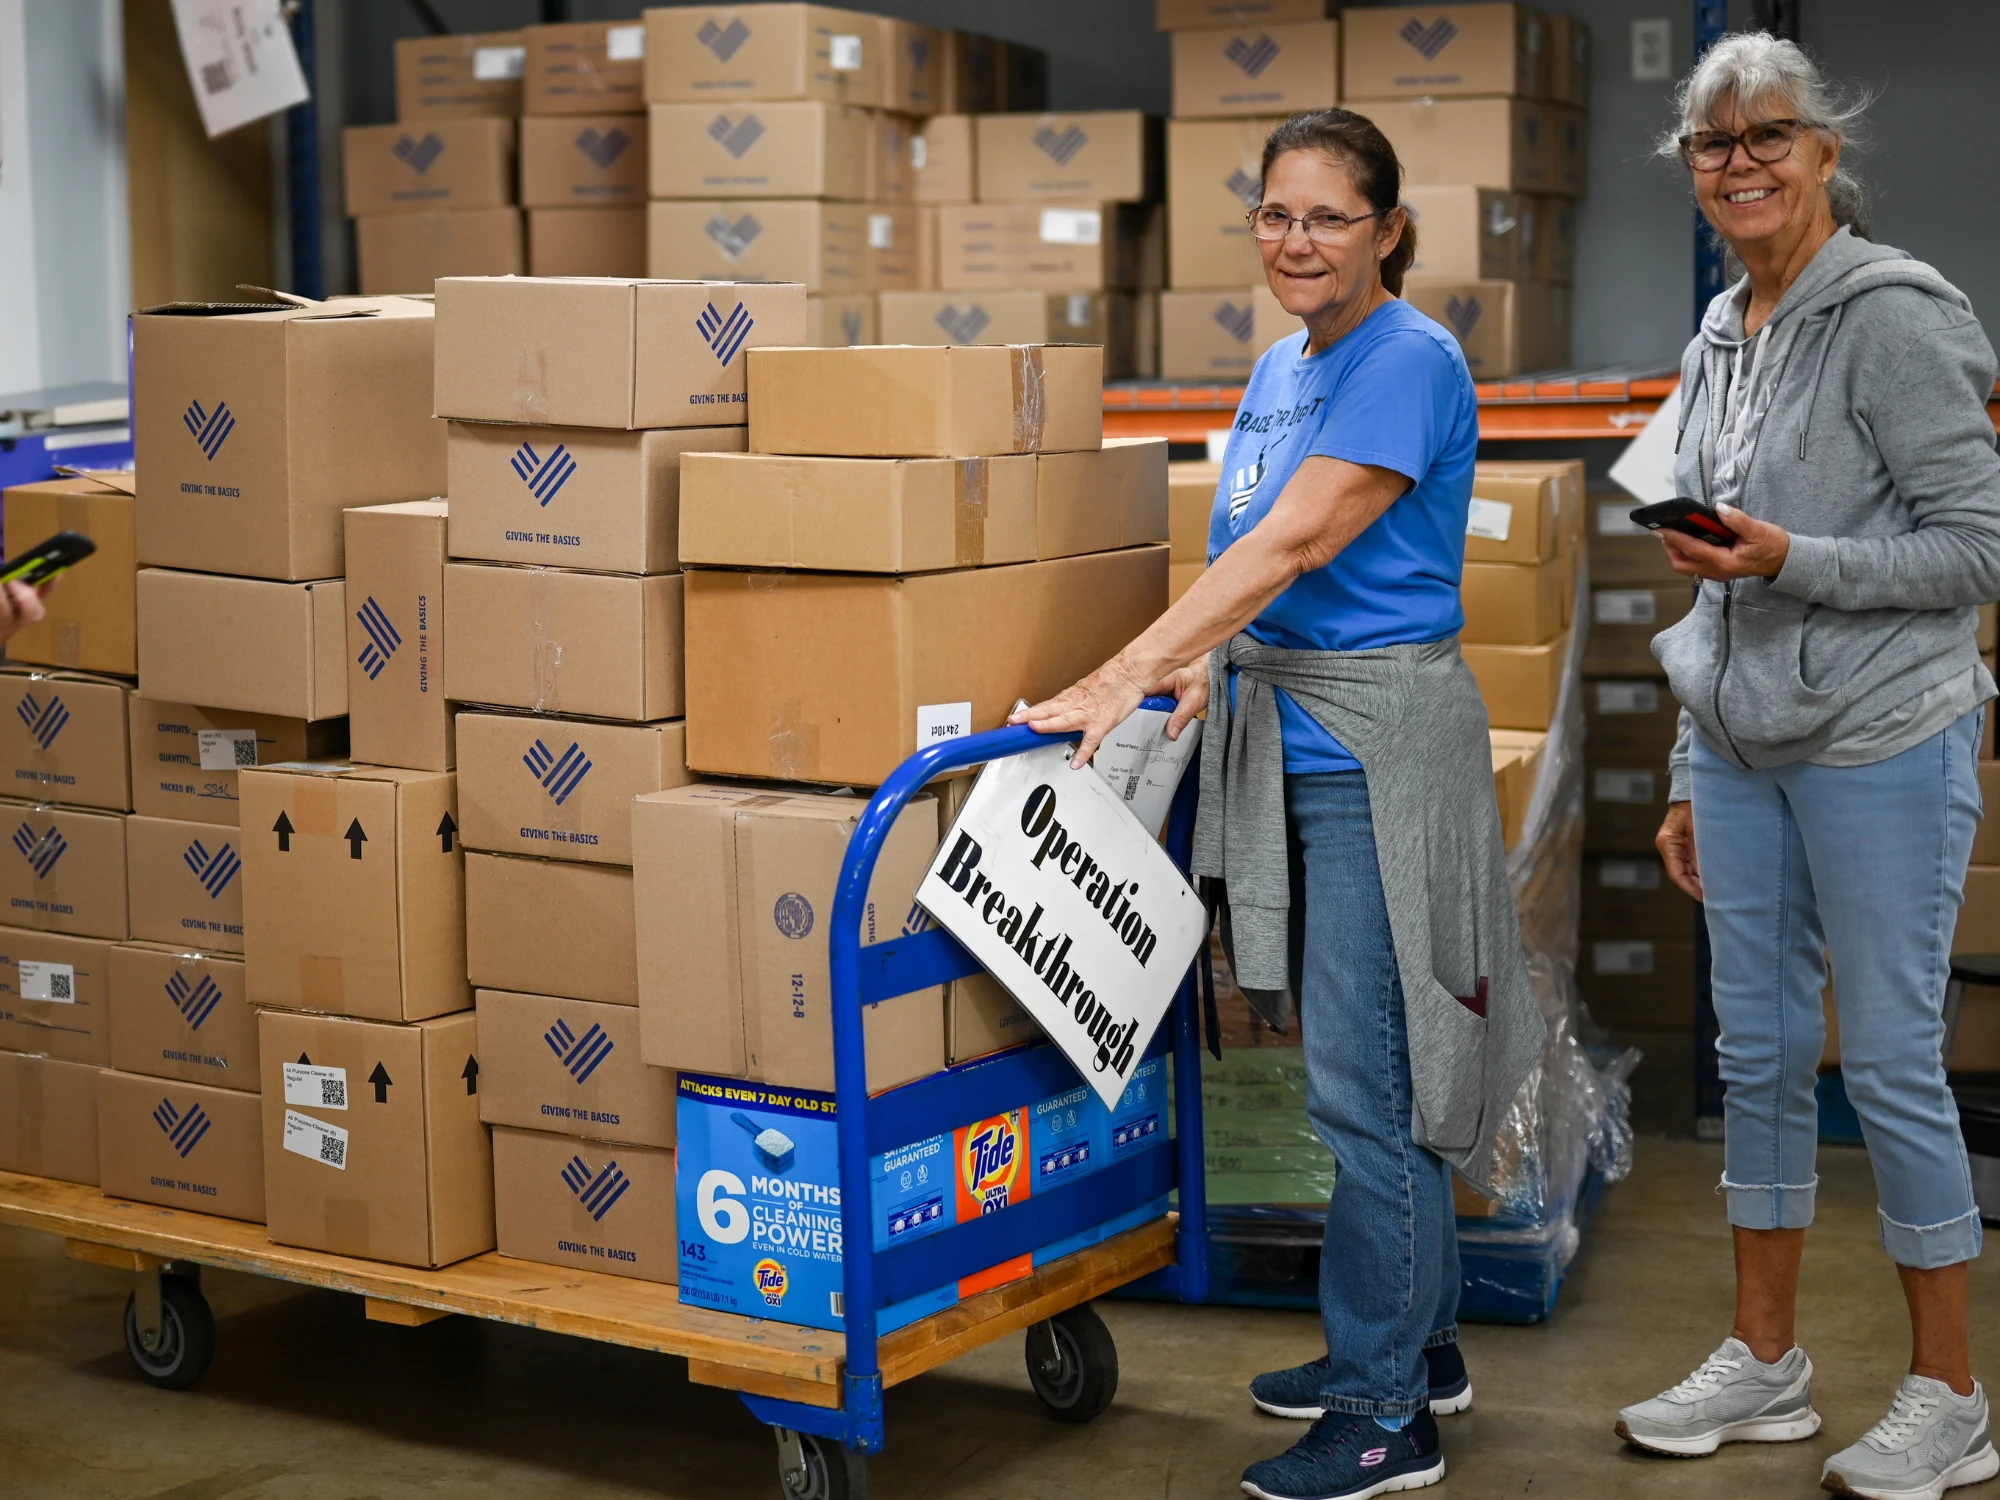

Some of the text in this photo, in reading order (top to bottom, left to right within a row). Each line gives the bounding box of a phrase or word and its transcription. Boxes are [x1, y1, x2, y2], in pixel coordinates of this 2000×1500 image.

[690, 392, 748, 405] GIVING THE BASI
[1234, 410, 1274, 434] RACE
[180, 482, 240, 498] GIVING THE BASICS
[505, 530, 581, 547] GIVING THE BASICS
[418, 595, 426, 631] BASICS
[420, 656, 428, 693] GIVING
[157, 723, 191, 735] CONTENTS:
[931, 724, 959, 737] 24x10ct
[158, 752, 192, 765] QUANTITY:
[15, 768, 38, 781] GIVING
[53, 774, 76, 785] BASICS
[160, 782, 196, 794] PACKED BY:
[520, 827, 599, 845] GIVING THE BASICS
[1020, 783, 1157, 969] Operation
[11, 897, 74, 915] GIVING THE BASICS
[181, 918, 244, 936] GIVING THE BASIC
[867, 902, 876, 943] GIVING
[935, 828, 1140, 1079] Breakthrough
[790, 973, 805, 1019] 12-12-6
[162, 1049, 187, 1062] GIVING
[189, 1053, 202, 1064] THE
[286, 1074, 303, 1082] Regular
[292, 1068, 310, 1076] Purpose
[310, 1070, 327, 1078] Cleaner
[680, 1078, 838, 1114] ATTACKS EVEN 7 DAY OLD ST
[541, 1104, 620, 1125] GIVING THE BASICS
[969, 1124, 1015, 1193] Tide
[151, 1176, 217, 1197] GIVING THE BASICS
[751, 1175, 841, 1206] MONTHS
[984, 1184, 1007, 1200] ULTRA
[696, 1169, 750, 1245] 6
[788, 1200, 804, 1211] OF
[982, 1194, 1008, 1216] OXI
[752, 1205, 843, 1233] CLEANING
[753, 1220, 843, 1255] POWER
[557, 1240, 637, 1263] GIVING THE BASICS
[680, 1239, 706, 1262] 143
[752, 1242, 843, 1263] EVEN IN COLD WATER
[757, 1269, 784, 1290] Tide
[681, 1285, 738, 1308] 250 OZ (15.6 LB) 7.1 kg
[764, 1296, 781, 1306] OXI
